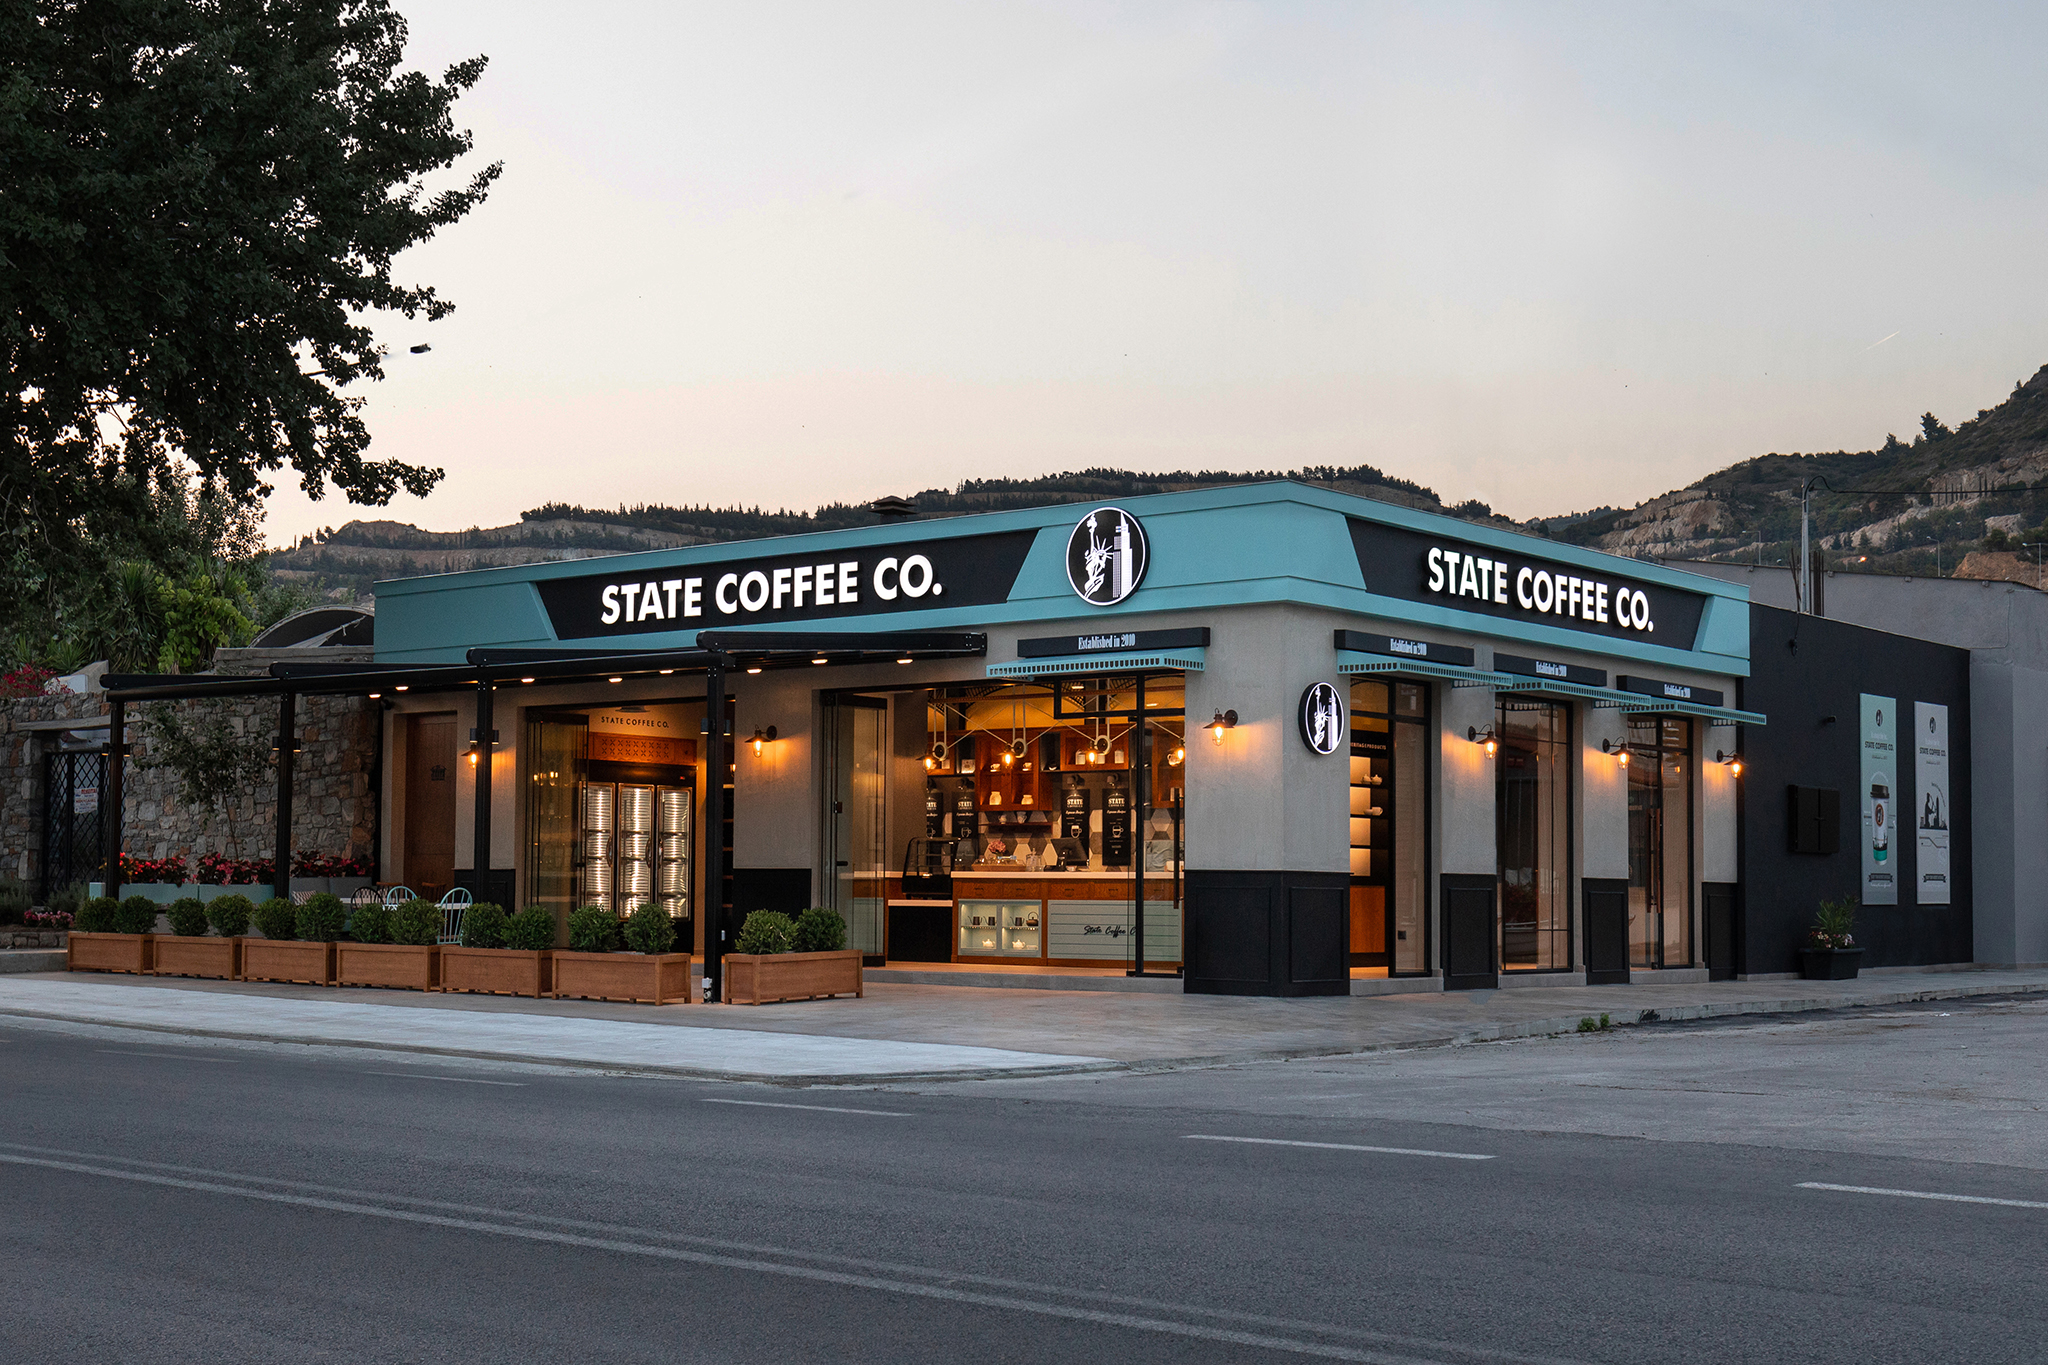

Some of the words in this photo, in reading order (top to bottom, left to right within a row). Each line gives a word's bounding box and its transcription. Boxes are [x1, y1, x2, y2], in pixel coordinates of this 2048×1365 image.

[601, 577, 702, 625] STATE
[715, 561, 859, 615] COFFEE
[873, 554, 943, 600] CO.
[1428, 547, 1508, 604] STATE
[1516, 566, 1608, 623] COFFEE
[1615, 587, 1655, 632] CO.
[601, 716, 623, 725] STATE
[626, 718, 654, 727] COFFEE
[1084, 925, 1102, 936] State
[1105, 925, 1126, 938] Coffee
